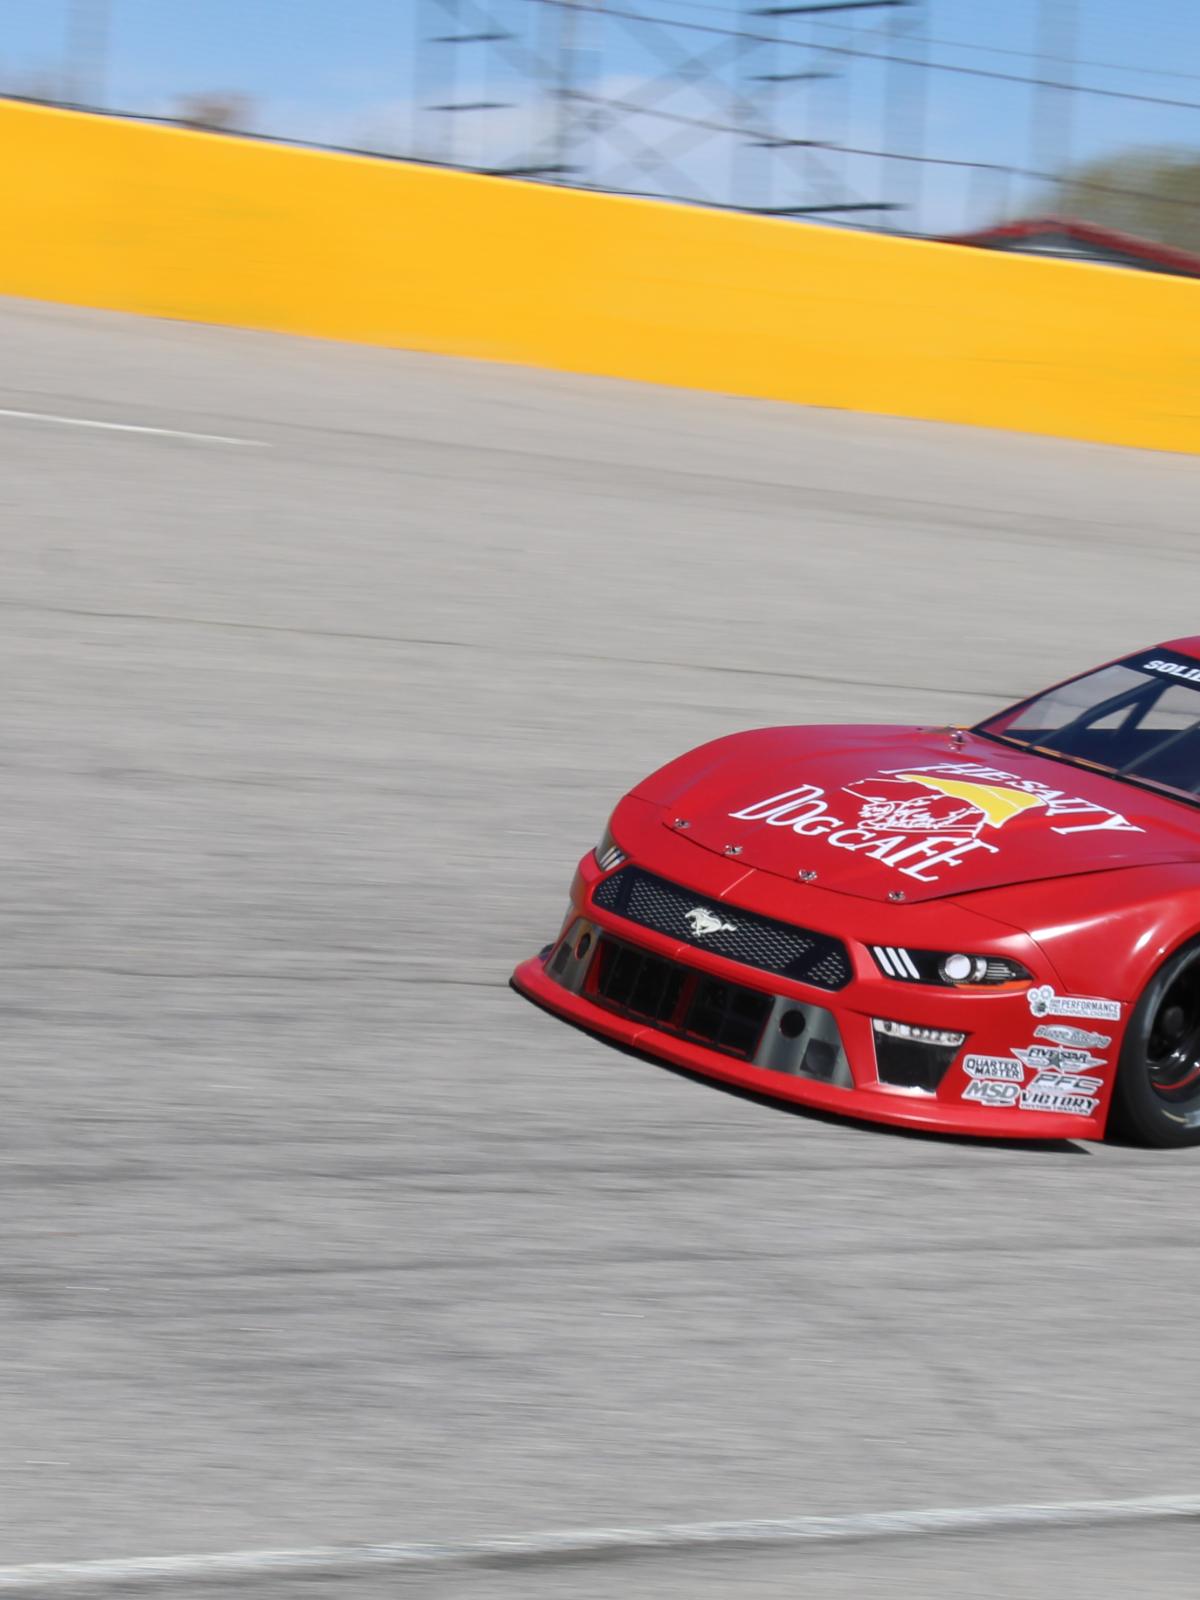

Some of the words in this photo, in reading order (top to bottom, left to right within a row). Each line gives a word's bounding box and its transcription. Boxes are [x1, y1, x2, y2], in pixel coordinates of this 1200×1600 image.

[727, 783, 844, 837] DOG
[1061, 1000, 1119, 1013] PERFORMANCE
[1028, 1048, 1058, 1059] FIVE
[1057, 1050, 1088, 1064] STAR
[966, 1057, 1020, 1072] QUARTER
[974, 1066, 1021, 1080] MASTER
[1034, 1073, 1102, 1090] PFC
[965, 1081, 1019, 1099] MSD
[1021, 1090, 1094, 1111] VICTORY
